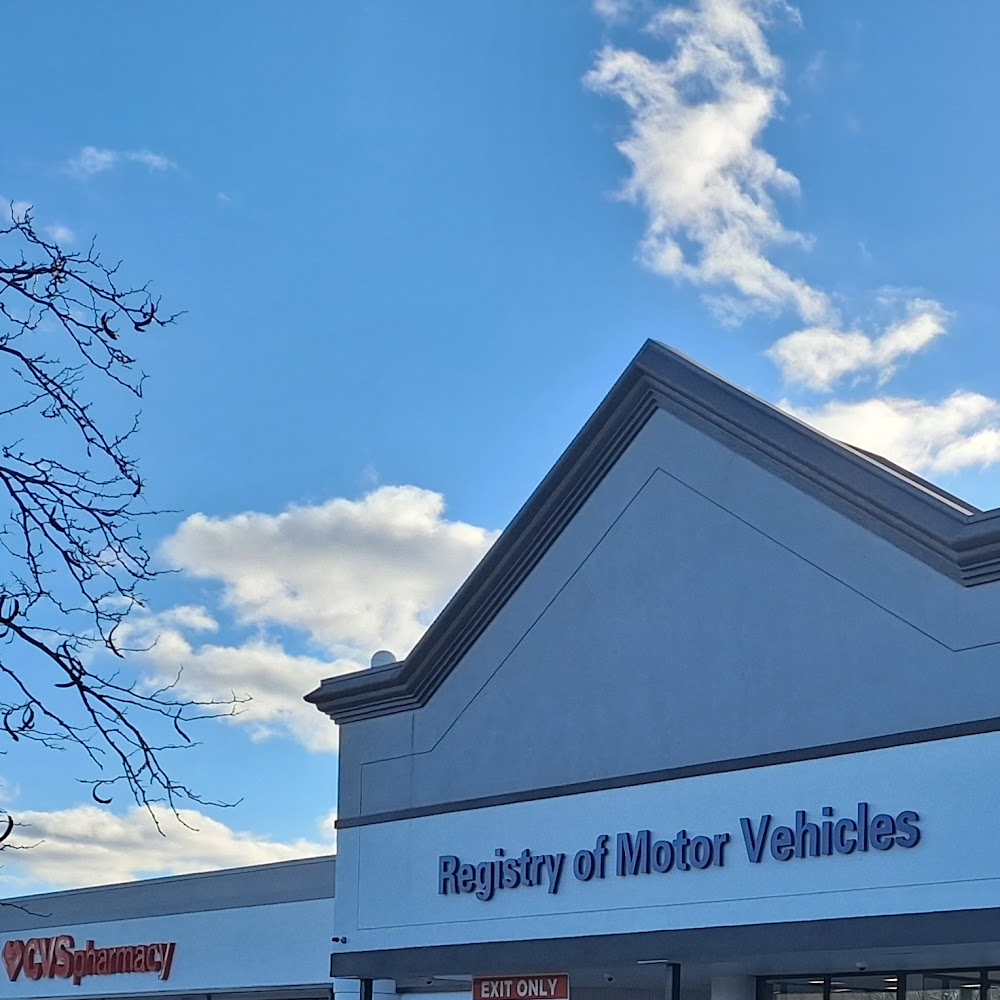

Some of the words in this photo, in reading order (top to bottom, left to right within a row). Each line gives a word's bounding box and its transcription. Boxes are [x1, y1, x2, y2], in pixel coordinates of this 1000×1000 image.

[438, 848, 565, 901] Registry
[573, 834, 609, 882] of
[616, 829, 730, 877] Motor
[740, 802, 921, 863] Vehicles
[481, 980, 513, 998] EXIT
[516, 978, 558, 997] ONLY
